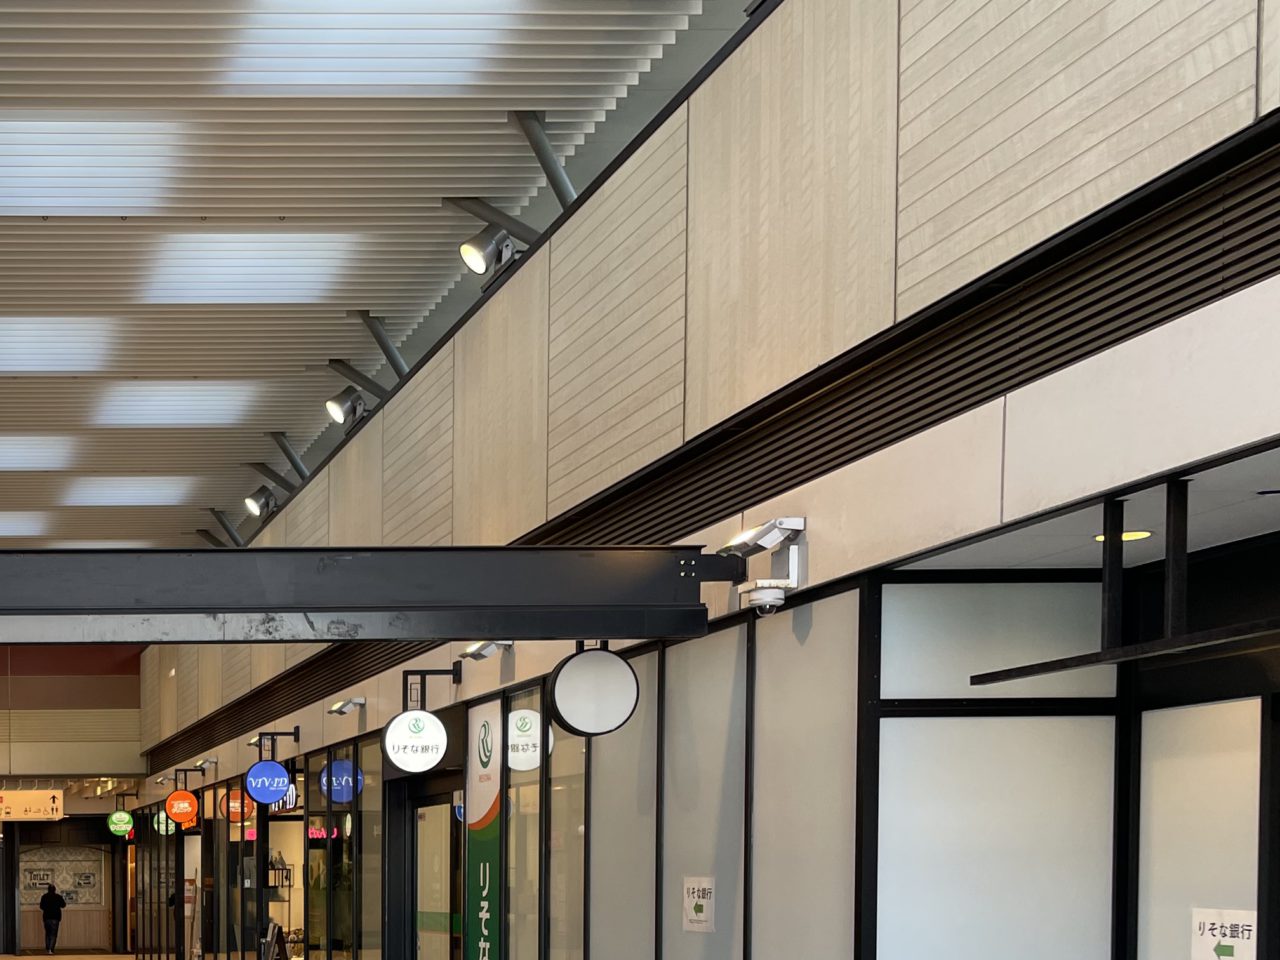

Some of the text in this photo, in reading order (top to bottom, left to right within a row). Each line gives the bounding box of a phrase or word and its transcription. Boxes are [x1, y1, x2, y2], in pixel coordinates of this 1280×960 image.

[392, 744, 440, 755] りそな銀行
[687, 887, 713, 900] りそな銀行
[1198, 921, 1253, 940] りそな銀行
